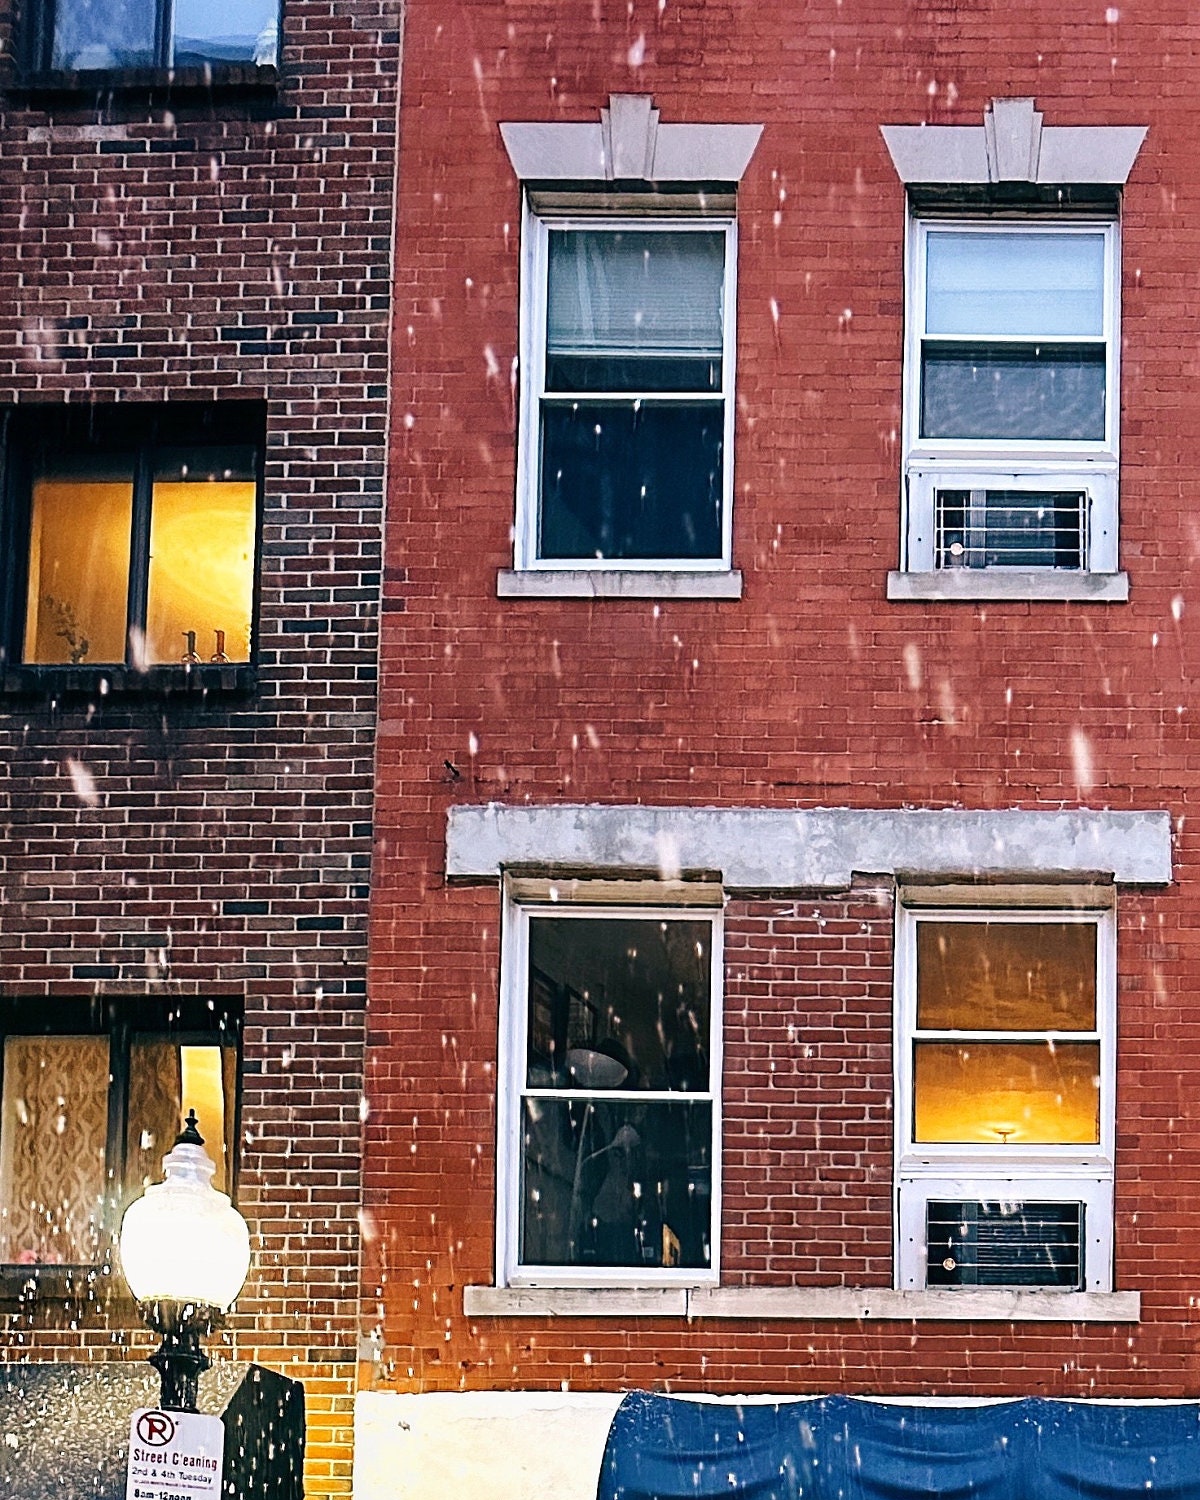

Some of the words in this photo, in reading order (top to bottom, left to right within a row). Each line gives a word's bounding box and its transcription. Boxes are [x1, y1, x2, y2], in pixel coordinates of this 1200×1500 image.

[133, 1448, 167, 1464] Street
[131, 1466, 148, 1476] 2nd
[151, 1469, 157, 1477] &
[161, 1470, 176, 1479] 4th
[178, 1471, 212, 1484] Tuesday
